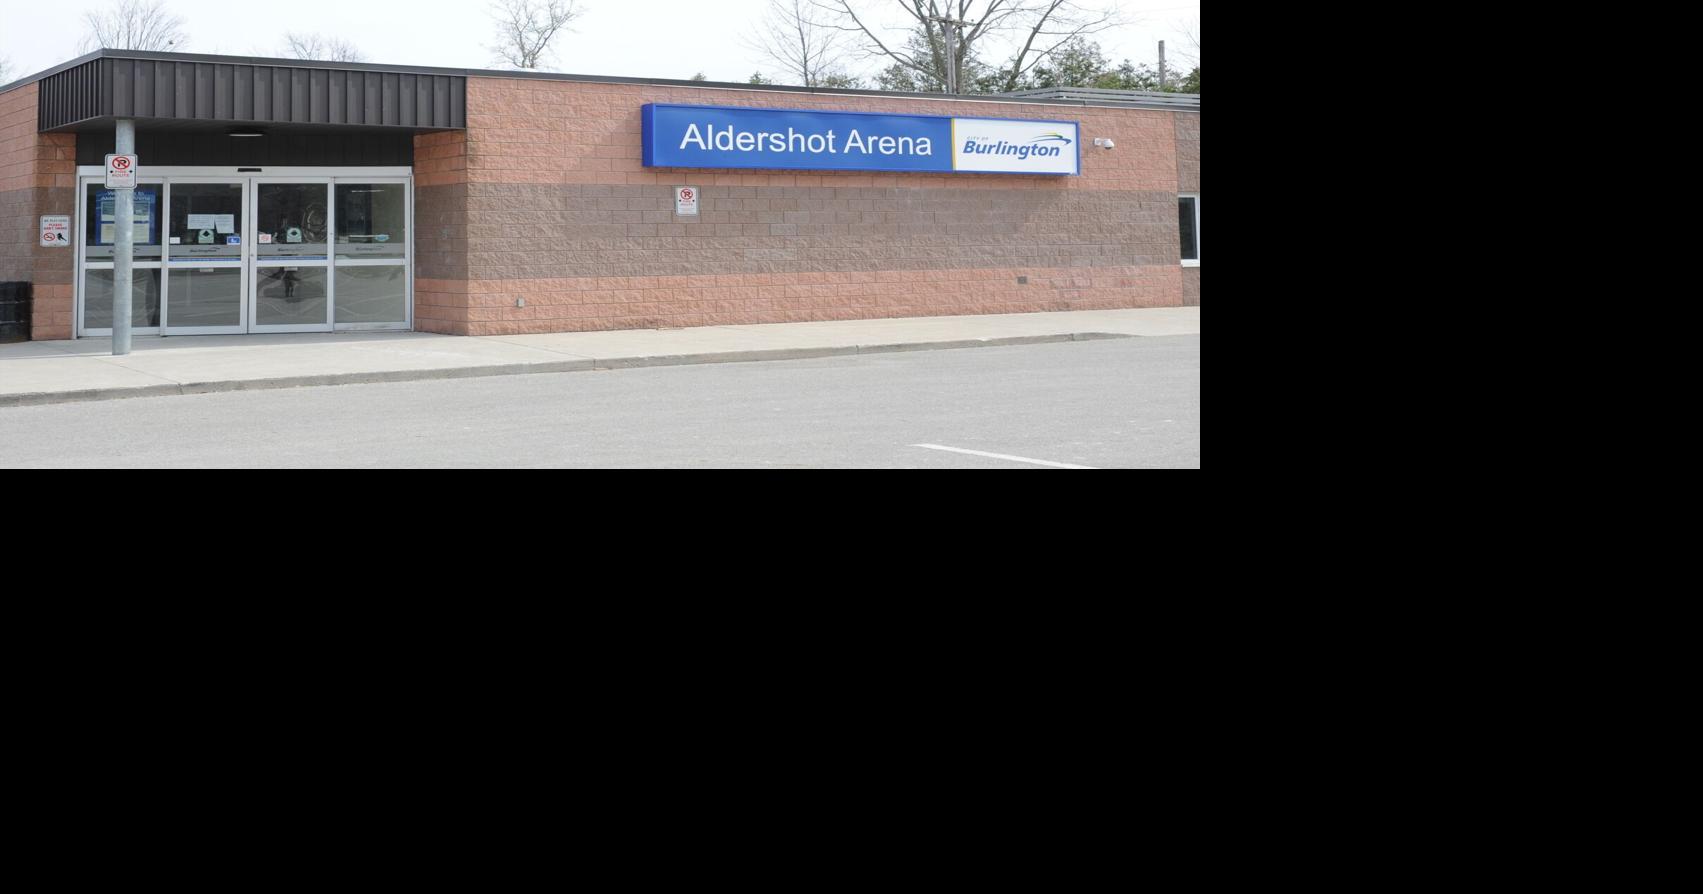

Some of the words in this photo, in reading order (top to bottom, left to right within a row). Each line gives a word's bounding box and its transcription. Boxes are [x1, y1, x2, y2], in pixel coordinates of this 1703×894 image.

[679, 123, 836, 154] Aldershot
[843, 129, 933, 156] Arena
[963, 140, 1060, 160] Burlington
